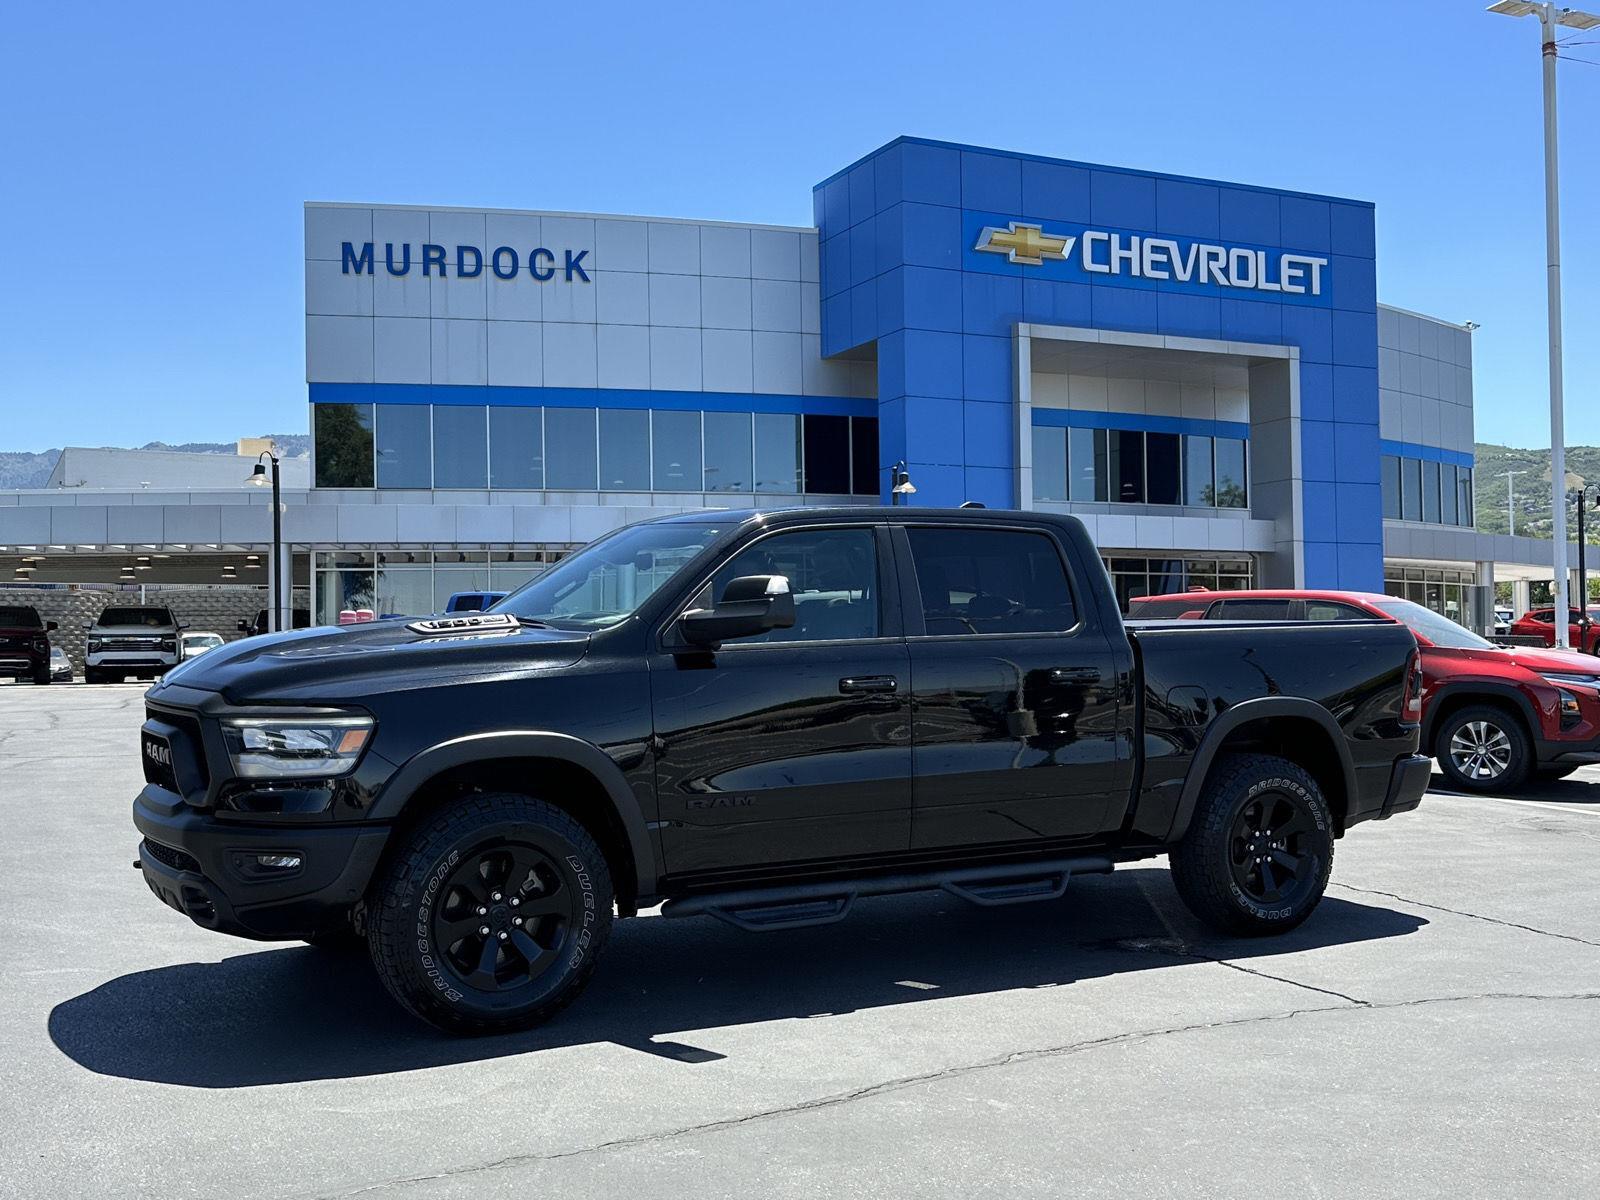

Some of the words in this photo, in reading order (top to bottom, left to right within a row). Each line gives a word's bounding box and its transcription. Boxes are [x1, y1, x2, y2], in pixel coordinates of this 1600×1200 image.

[341, 241, 591, 283] MURDOCK
[1083, 230, 1328, 295] CHEVROLET
[429, 617, 482, 630] 1500
[146, 741, 170, 765] RAM
[685, 795, 757, 810] RAM
[1248, 778, 1326, 831] BRIDGESTONE
[416, 850, 464, 1002] BRIDGESTONE
[565, 855, 595, 969] DUELER
